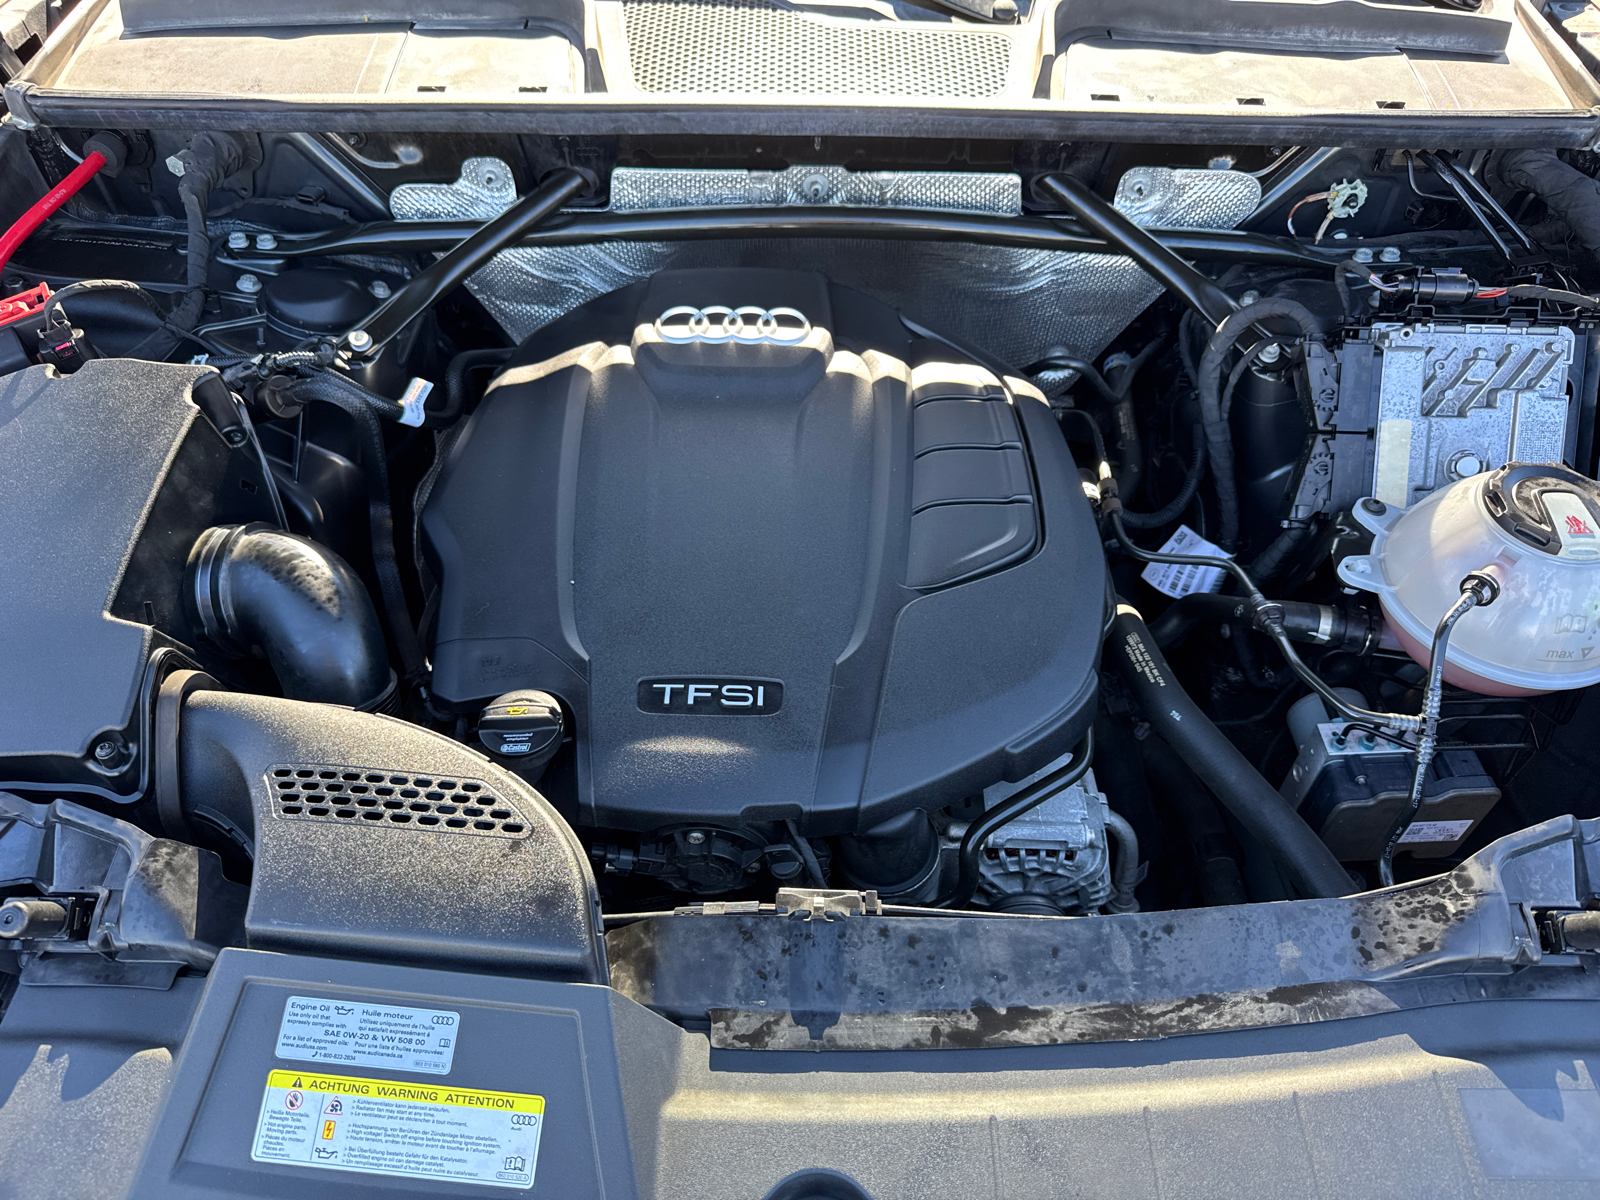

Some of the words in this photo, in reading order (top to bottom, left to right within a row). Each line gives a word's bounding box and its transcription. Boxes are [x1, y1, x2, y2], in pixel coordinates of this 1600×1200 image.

[1546, 650, 1574, 658] max
[1143, 666, 1156, 684] Mexico
[652, 684, 765, 708] TFSI
[291, 1002, 318, 1011] Engine
[362, 1009, 382, 1017] Huile
[324, 1030, 341, 1038] SAE
[343, 1032, 370, 1040] 0W-20
[389, 1029, 426, 1038] expressément
[282, 1043, 328, 1051] www.audiusa.com
[309, 1080, 370, 1095] ACHTUNG
[377, 1086, 439, 1102] WARNING
[444, 1094, 515, 1109] ATTENTION
[357, 1099, 395, 1108] Kühlerventilator
[430, 1131, 459, 1139] Zündanlage
[357, 1146, 386, 1156] Überfüllung
